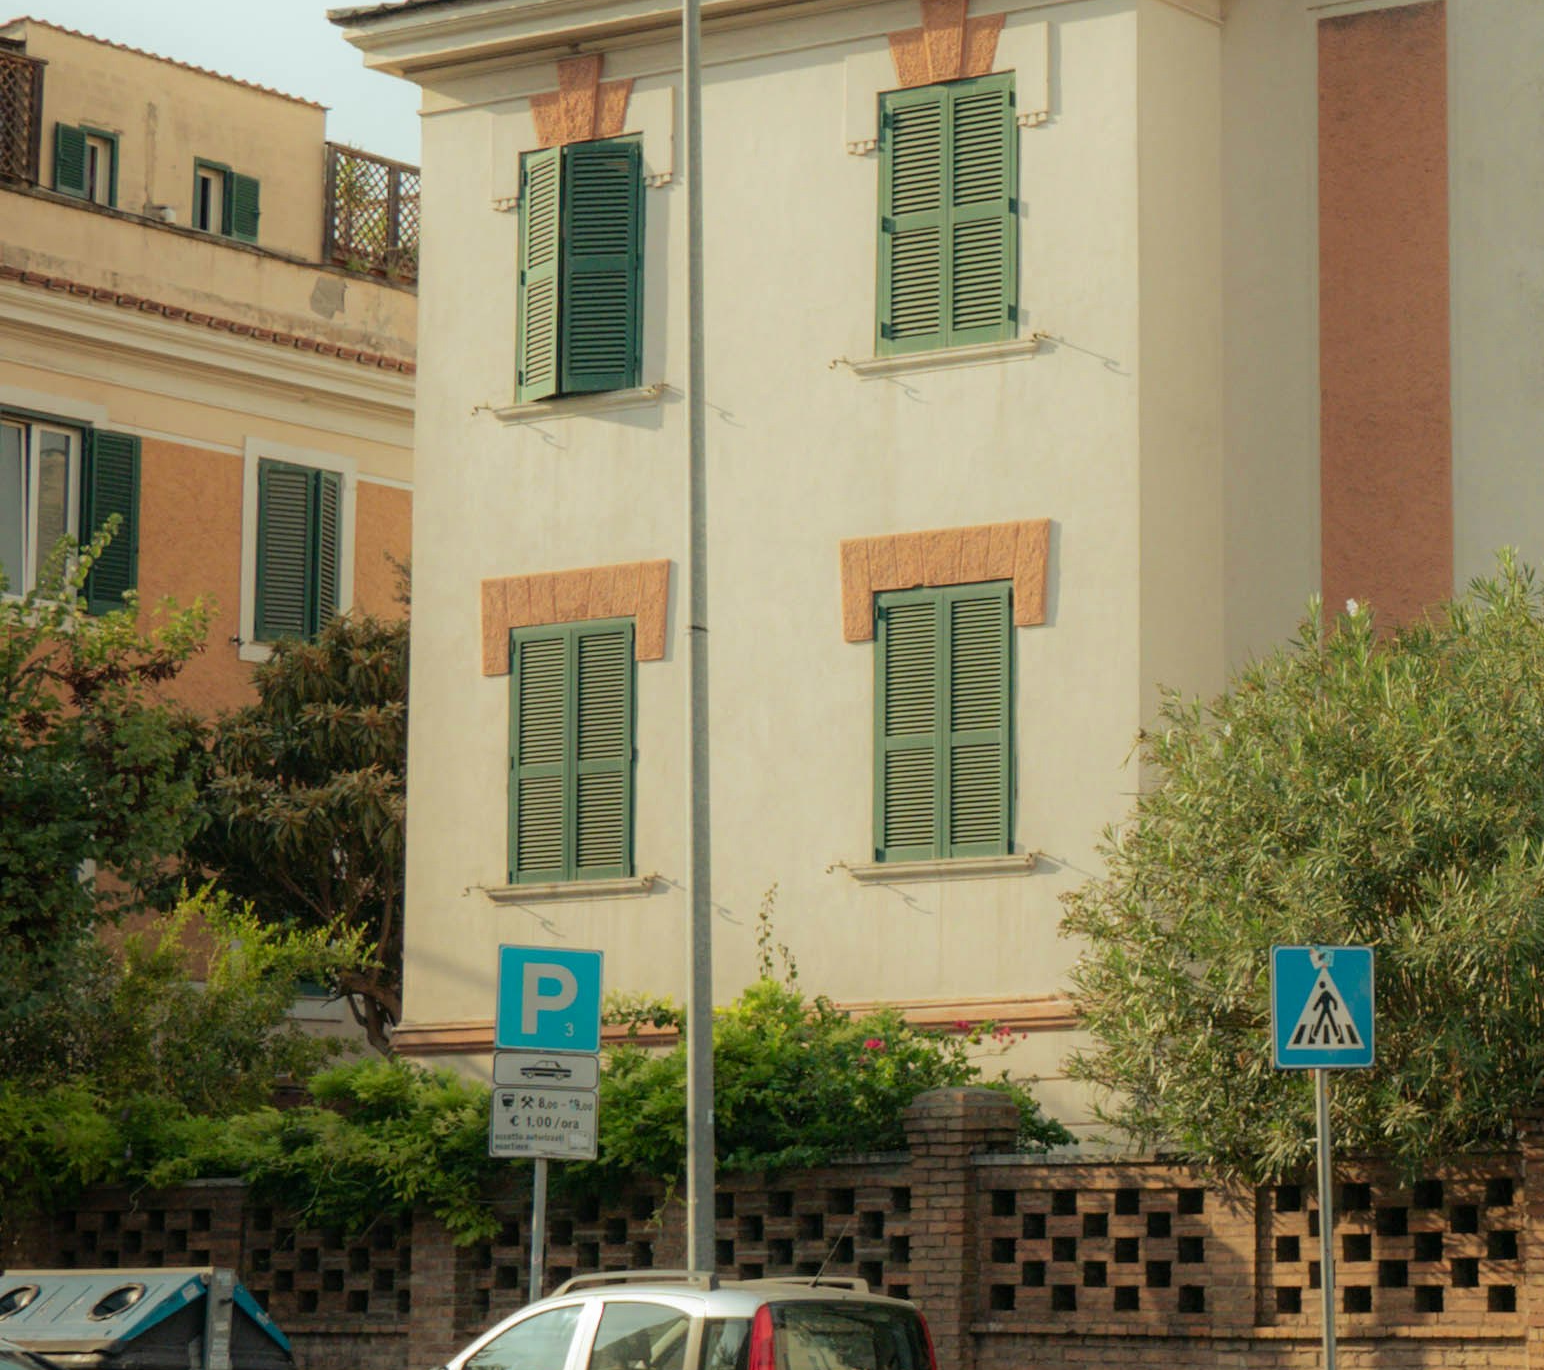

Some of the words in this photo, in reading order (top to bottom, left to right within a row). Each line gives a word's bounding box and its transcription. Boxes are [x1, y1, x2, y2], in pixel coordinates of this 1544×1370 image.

[521, 962, 579, 1035] P
[563, 1021, 575, 1038] 3
[510, 1115, 519, 1127] €
